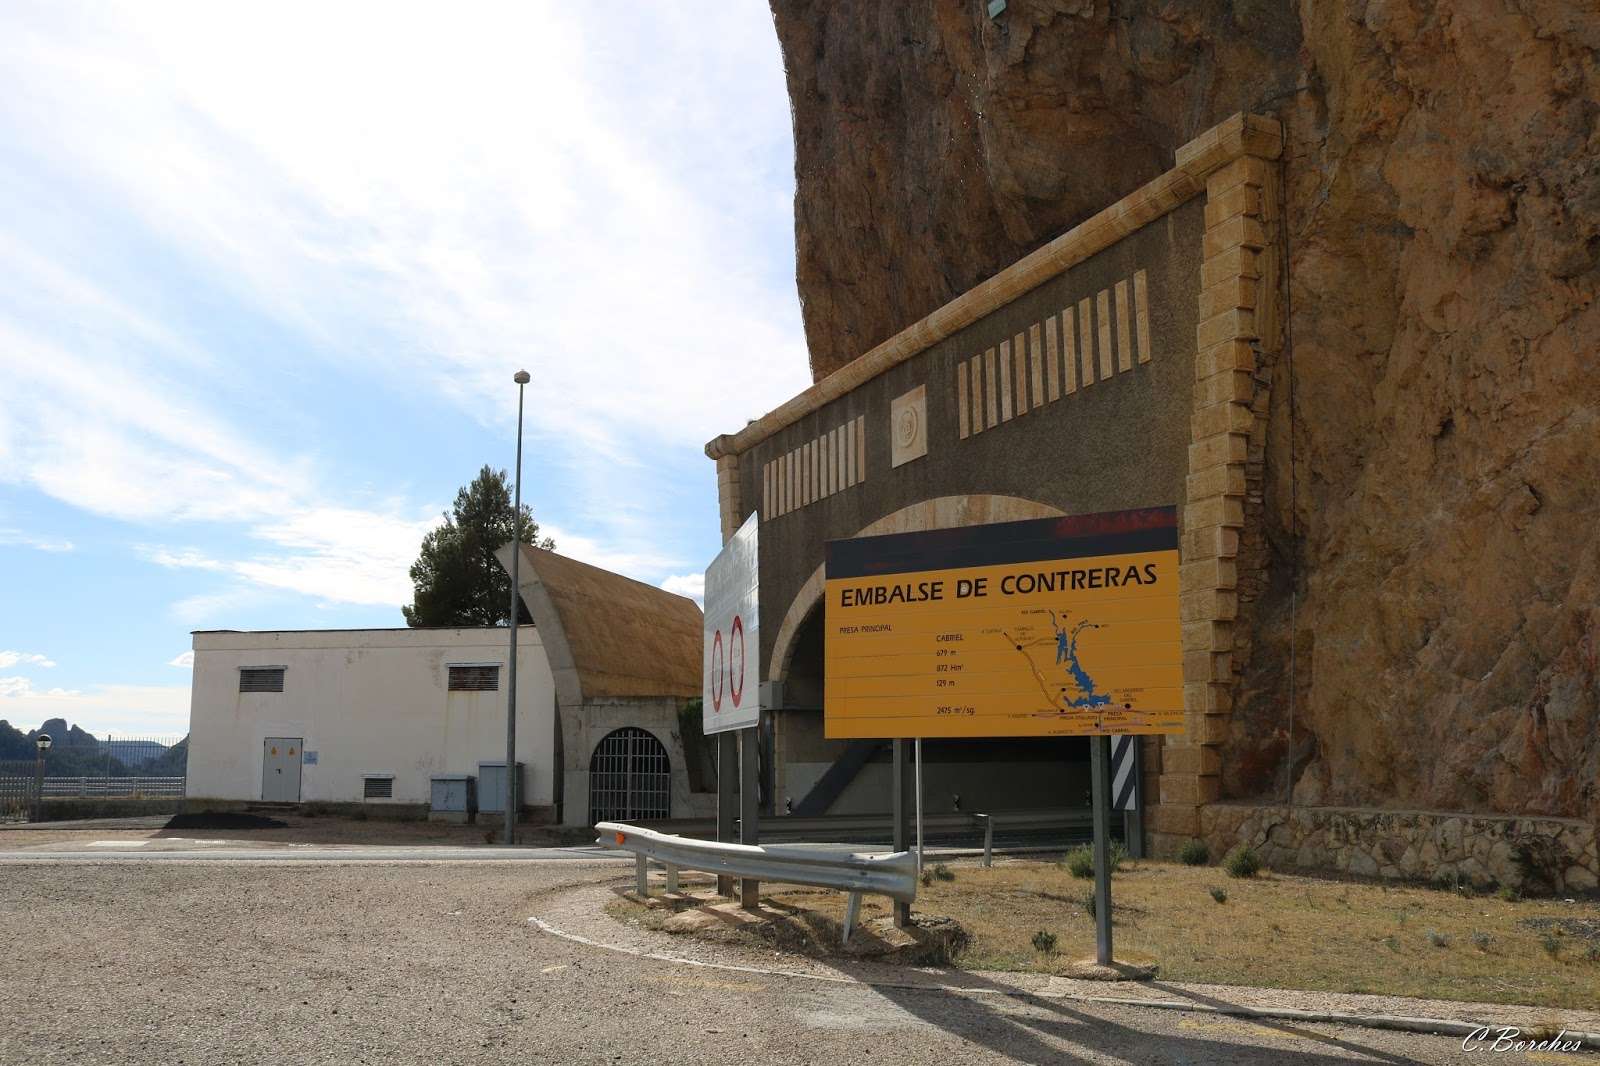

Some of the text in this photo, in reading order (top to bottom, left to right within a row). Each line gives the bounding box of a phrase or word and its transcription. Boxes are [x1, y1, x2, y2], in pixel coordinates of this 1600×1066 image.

[840, 563, 1158, 608] EMBALSE DE CONTRERAS
[839, 624, 892, 634] PRESA PRINCIPAL
[936, 633, 964, 643] CABRIEL
[936, 649, 948, 657] 679
[936, 664, 948, 672] 872
[936, 679, 947, 687] 129
[937, 706, 952, 715] 2475
